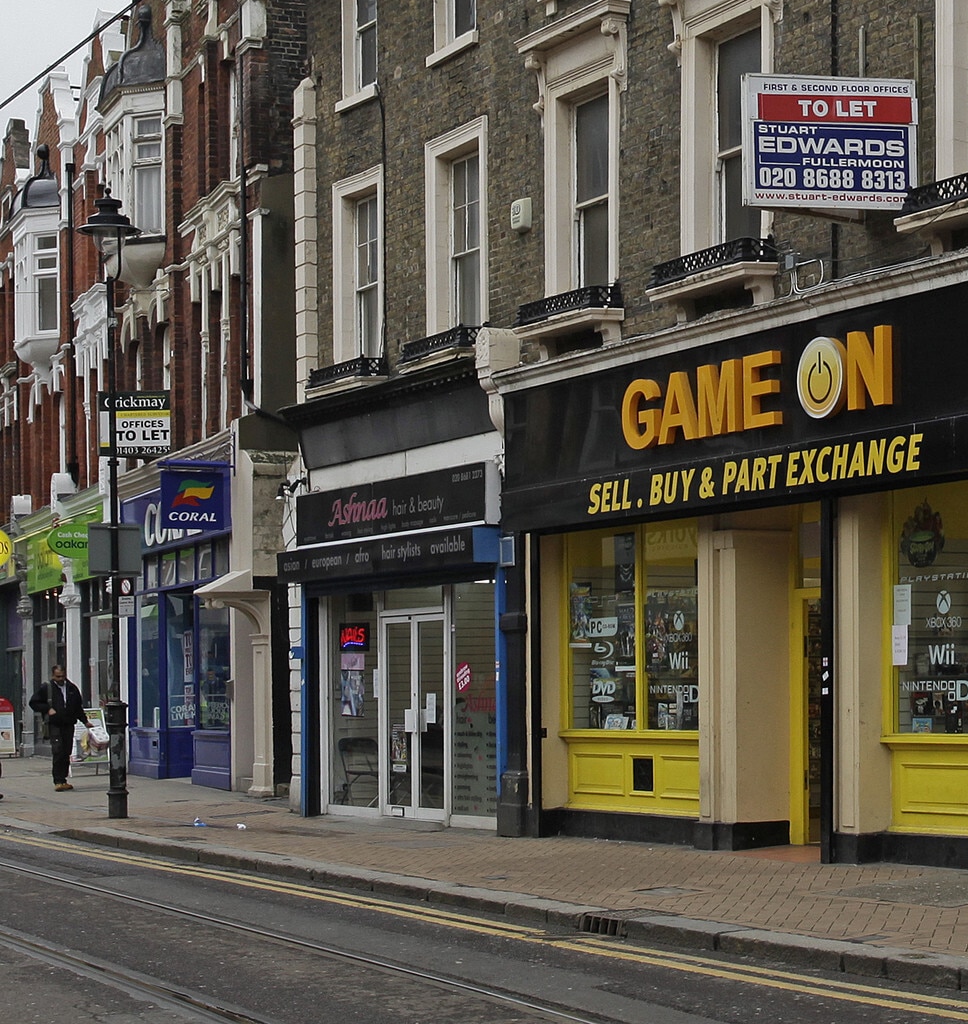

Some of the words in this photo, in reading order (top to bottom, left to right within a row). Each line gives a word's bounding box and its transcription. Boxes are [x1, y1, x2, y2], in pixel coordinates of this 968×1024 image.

[763, 83, 788, 91] FIRST
[801, 84, 838, 92] SECOND
[841, 85, 870, 93] FLOOR
[873, 86, 909, 94] OFFICES
[798, 99, 829, 117] TO
[835, 100, 877, 118] LET
[758, 124, 818, 135] STUART
[758, 136, 905, 157] EDWARDS
[802, 157, 905, 168] FULLERMOON
[759, 167, 796, 188] 020
[803, 168, 855, 189] 8688
[861, 170, 906, 190] 8313
[621, 350, 783, 450] GAME
[797, 325, 893, 419] ON
[121, 420, 164, 428] OFFICES
[116, 430, 136, 441] TO
[142, 429, 169, 441] LET
[588, 479, 632, 514] SELL
[650, 468, 695, 506] BUY
[699, 466, 715, 499] &
[722, 454, 782, 495] PART
[786, 433, 924, 487] EXCHANGE
[392, 499, 407, 516] hair
[409, 496, 416, 513] &
[417, 494, 444, 514] beauty
[168, 511, 217, 522] CORAL
[311, 555, 342, 571] european
[354, 547, 370, 563] afro
[381, 543, 396, 560] hair
[397, 541, 421, 562] stylists
[430, 535, 466, 554] available
[591, 619, 602, 634] PC
[669, 652, 689, 670] Wii
[928, 643, 955, 665] Wii
[592, 678, 616, 696] DVD
[650, 684, 689, 695] NINTENDO
[902, 681, 955, 692] NINTENDO
